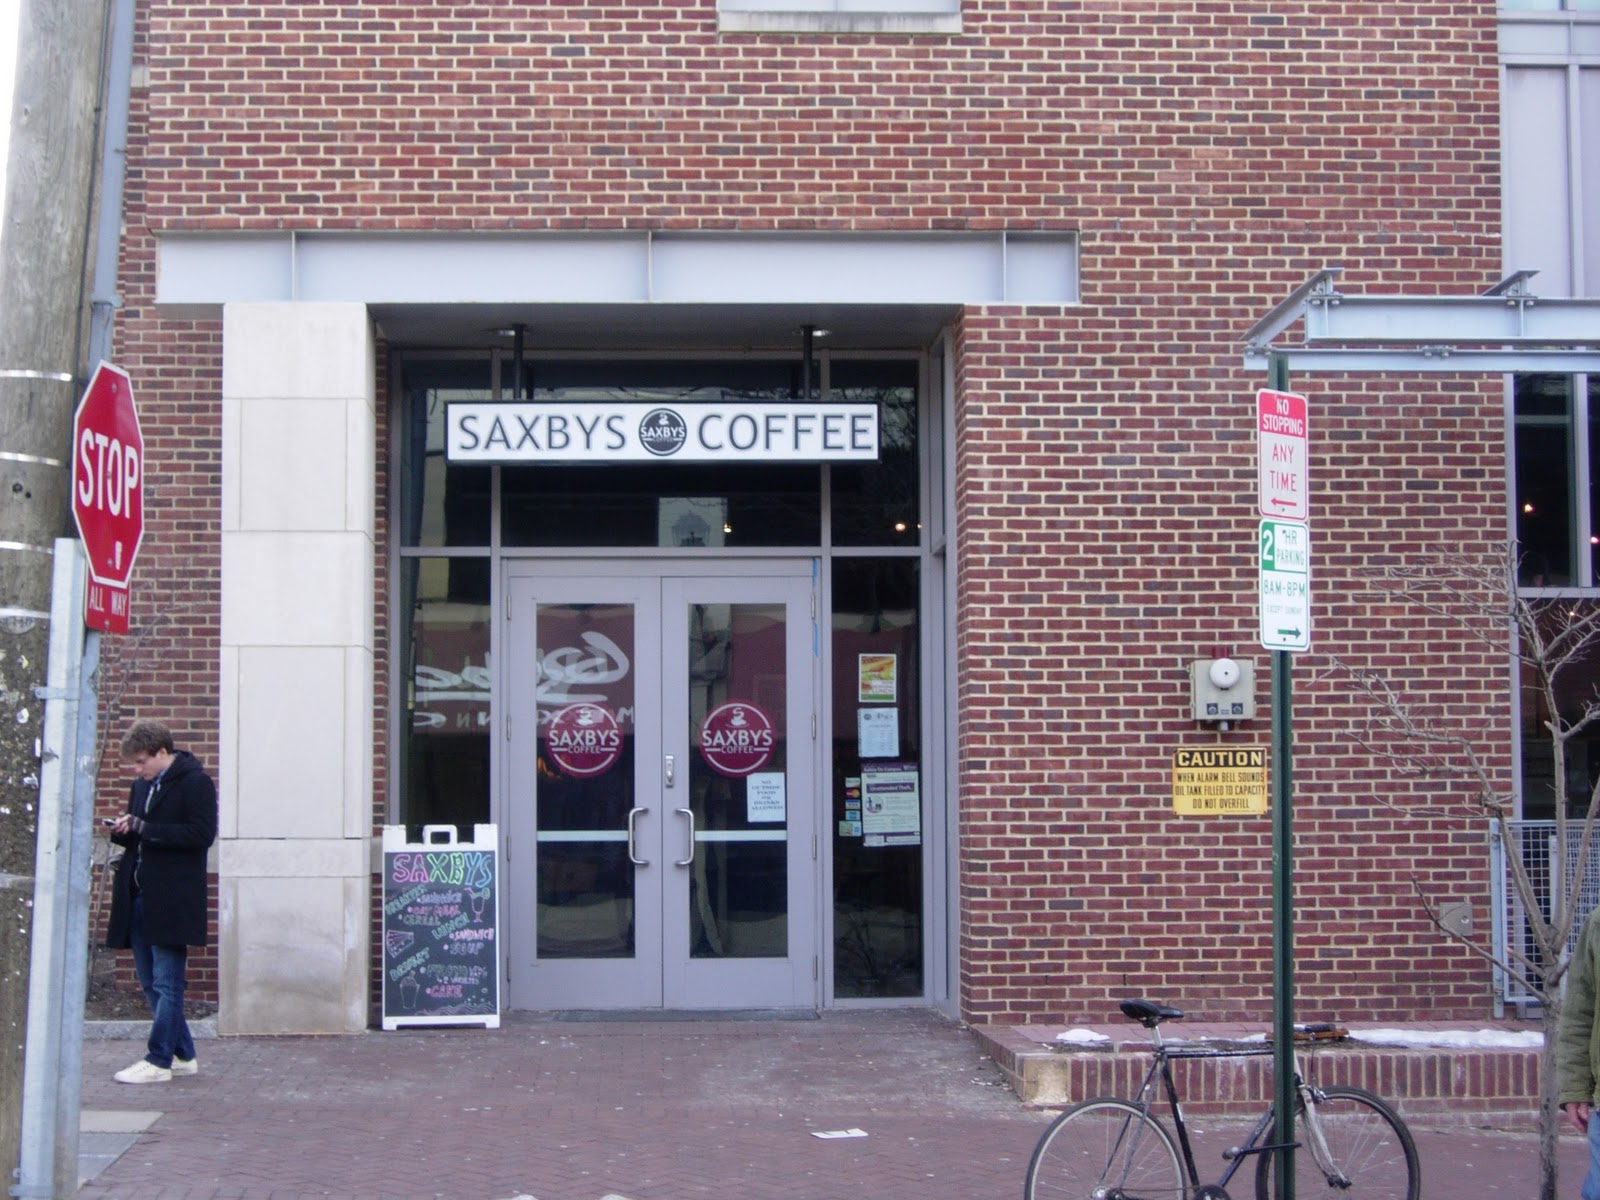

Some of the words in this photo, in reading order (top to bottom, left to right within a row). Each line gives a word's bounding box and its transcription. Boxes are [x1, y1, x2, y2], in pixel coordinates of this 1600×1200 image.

[1276, 398, 1290, 415] NO
[458, 414, 627, 451] SAXBYS
[698, 413, 873, 451] COFFEE
[640, 426, 686, 439] SAXBYS
[1262, 413, 1304, 436] STOPPING
[1272, 443, 1295, 464] ANY
[78, 427, 140, 519] STOP
[1269, 470, 1297, 493] TIME
[1262, 529, 1274, 561] 2
[1284, 529, 1298, 546] HR
[1276, 547, 1305, 566] PARKING
[89, 585, 105, 612] ALL
[111, 590, 128, 617] WAY
[548, 729, 621, 747] SAXBYS
[701, 729, 773, 747] SAXBYS
[567, 745, 601, 754] COFFEE
[721, 745, 755, 754] COFFEE
[1177, 751, 1263, 767] CAUTION
[1177, 772, 1195, 783] WHEN
[1197, 772, 1219, 783] ALARM
[1221, 772, 1236, 783] BELL
[1238, 772, 1265, 783] SOUNDS
[1175, 785, 1185, 796] OIL
[1186, 785, 1202, 796] TANK
[1204, 785, 1224, 796] FILLED
[1226, 785, 1233, 796] TO
[1235, 785, 1266, 796] CAPACITY
[1193, 798, 1203, 809] DO
[1205, 798, 1217, 809] NOT
[1220, 798, 1250, 809] OVERFILL
[392, 852, 493, 888] SAXBYS
[403, 914, 441, 926] CEREAL
[432, 912, 471, 941] LUNCH
[453, 928, 495, 941] SANDWICH
[450, 942, 485, 956] SOUP
[430, 984, 463, 998] CAKE
